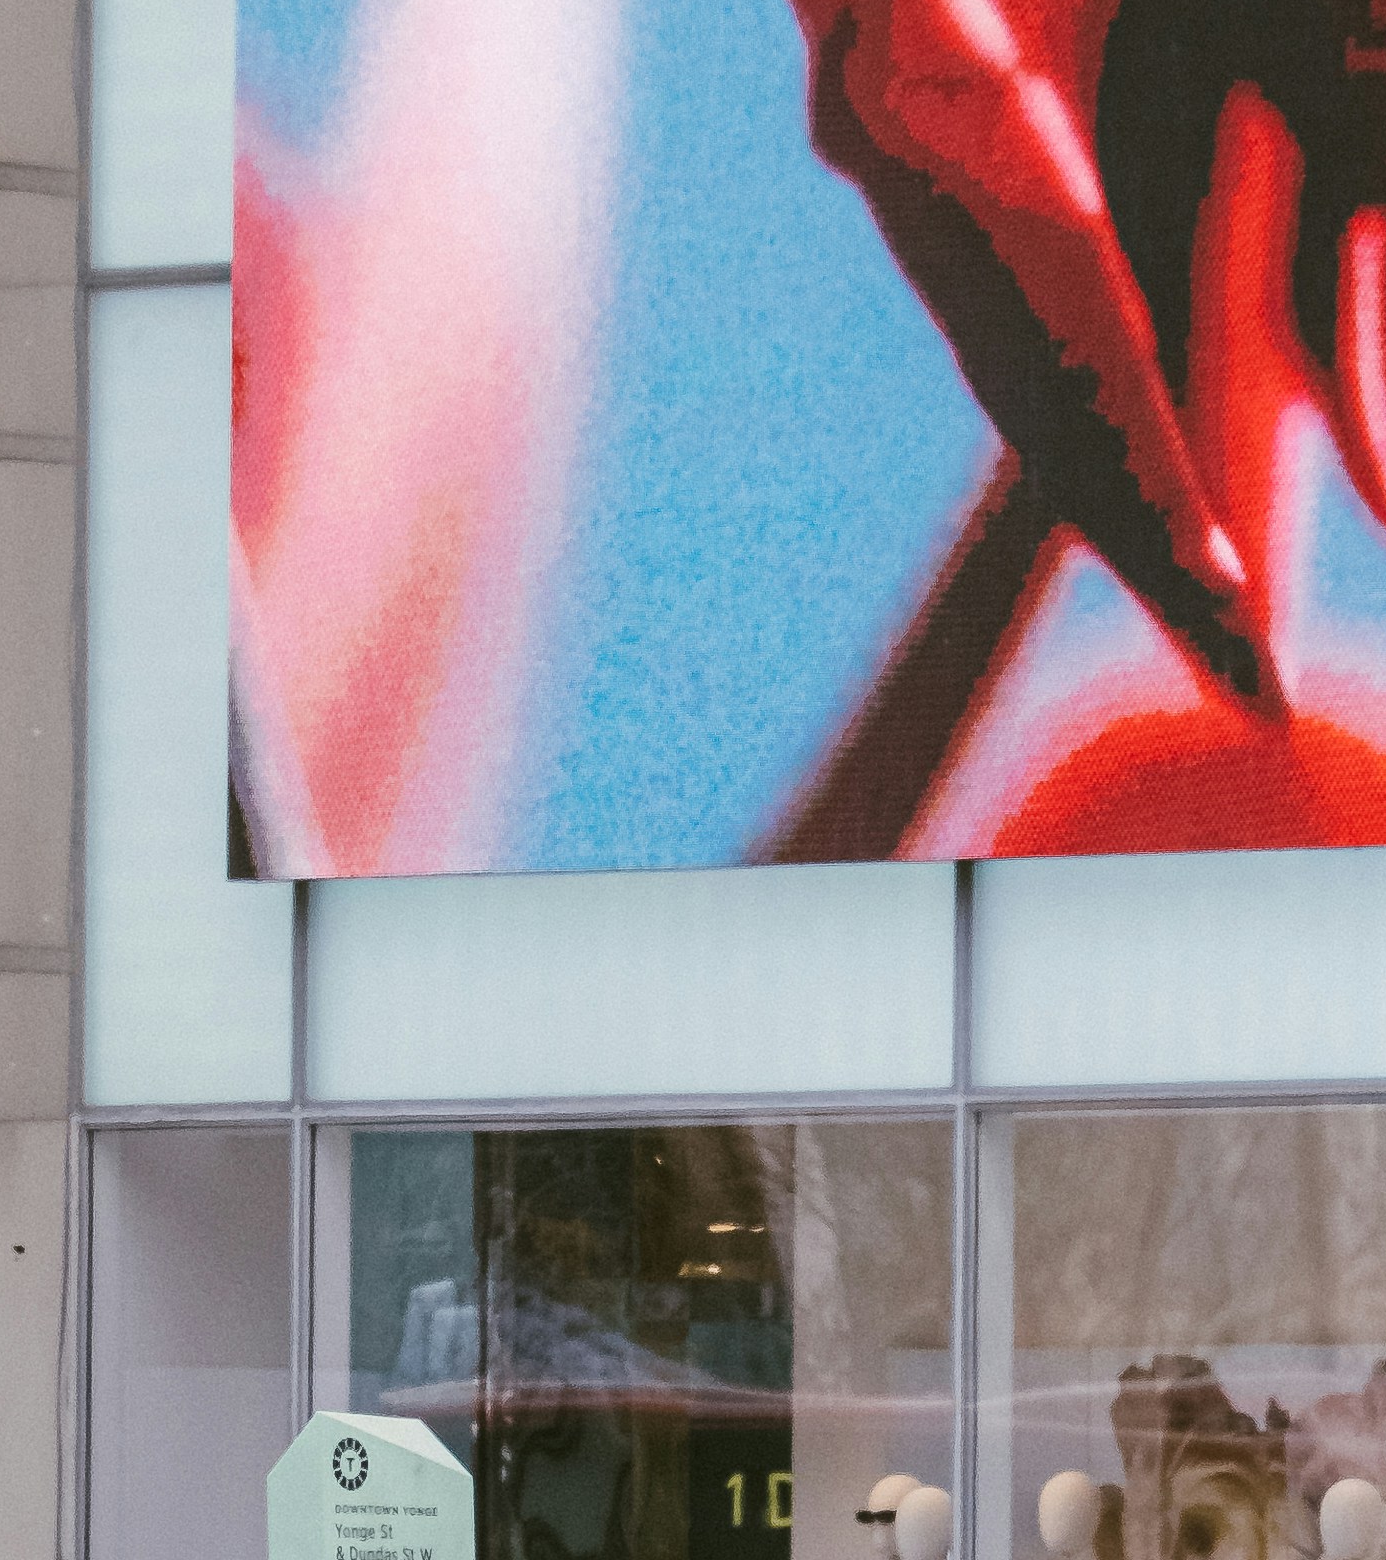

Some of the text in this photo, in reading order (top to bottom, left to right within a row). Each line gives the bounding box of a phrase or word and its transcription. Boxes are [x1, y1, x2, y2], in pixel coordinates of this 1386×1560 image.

[334, 1504, 399, 1515] DOWNTOWN
[335, 1523, 394, 1542] Yonge St
[336, 1545, 345, 1560] &
